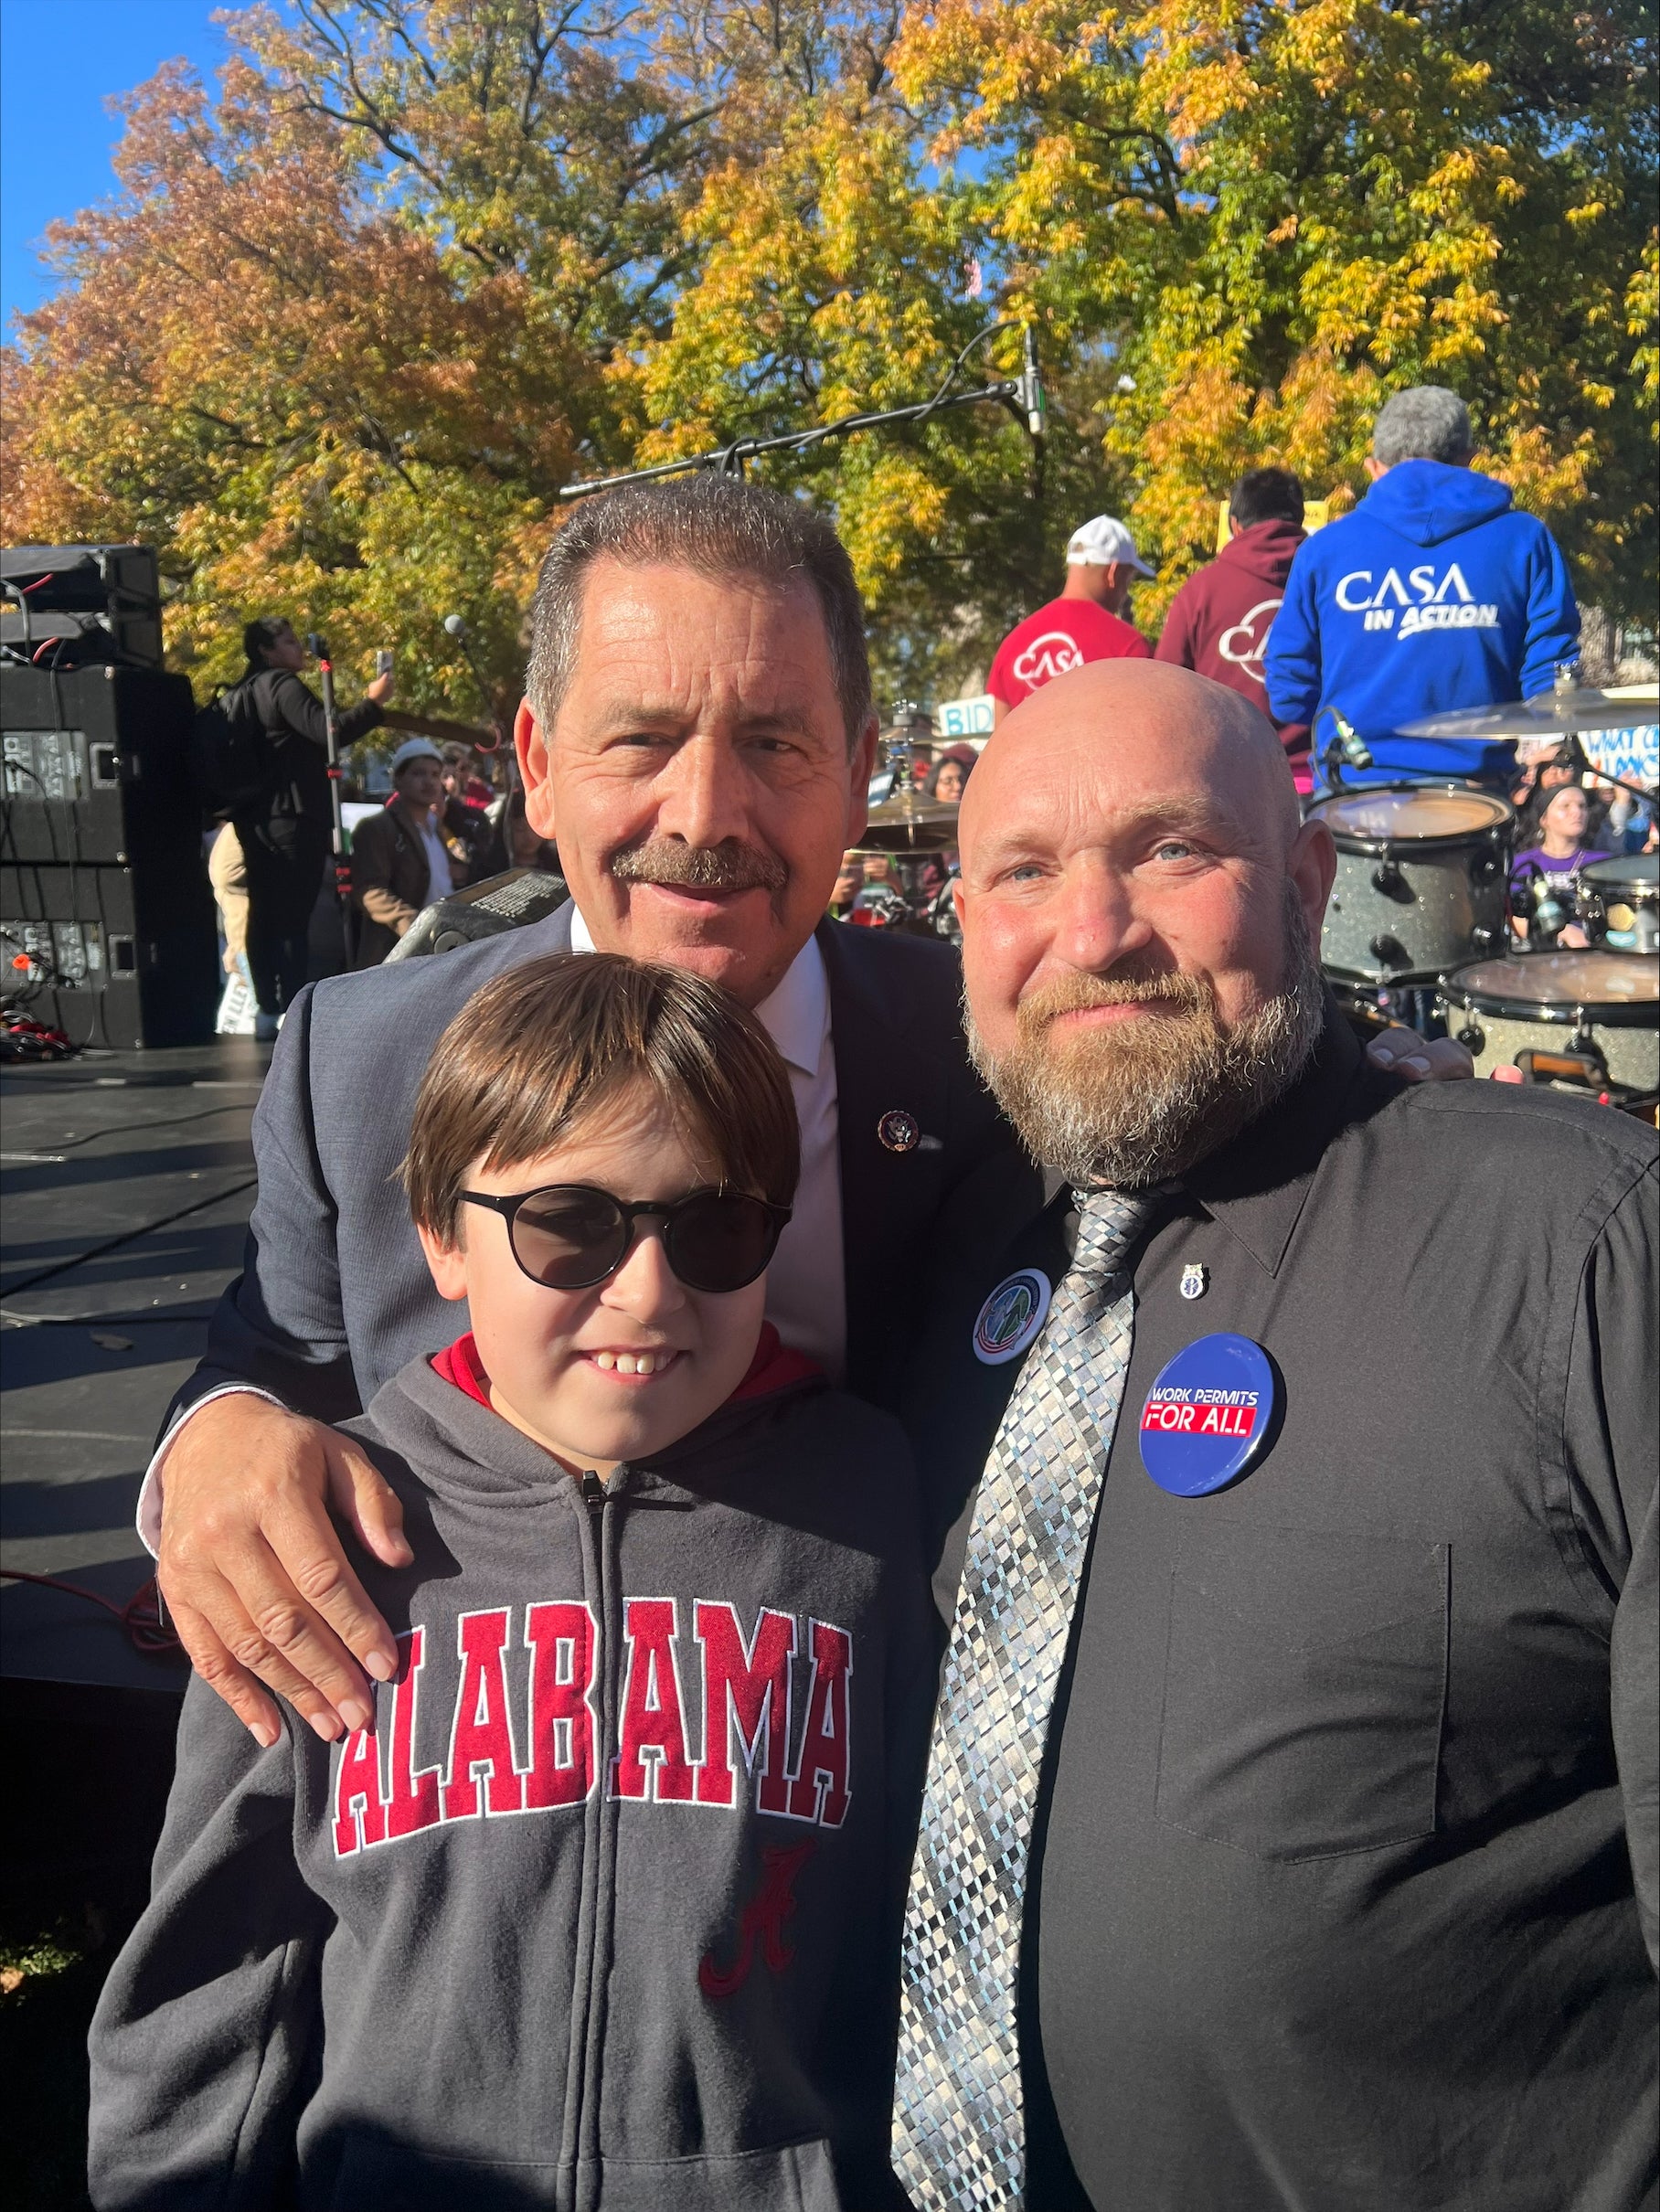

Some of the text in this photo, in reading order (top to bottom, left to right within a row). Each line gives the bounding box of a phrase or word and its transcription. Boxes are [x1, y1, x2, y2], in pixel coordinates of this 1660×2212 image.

[1335, 562, 1476, 611] CASA
[1363, 604, 1500, 635] IN ACTION
[1013, 649, 1085, 680] CASA
[946, 704, 992, 736] BID
[1152, 1388, 1260, 1406] WORK PERMITS
[1145, 1404, 1247, 1434] FOR ALL
[332, 1597, 854, 1861] ALABAMA
